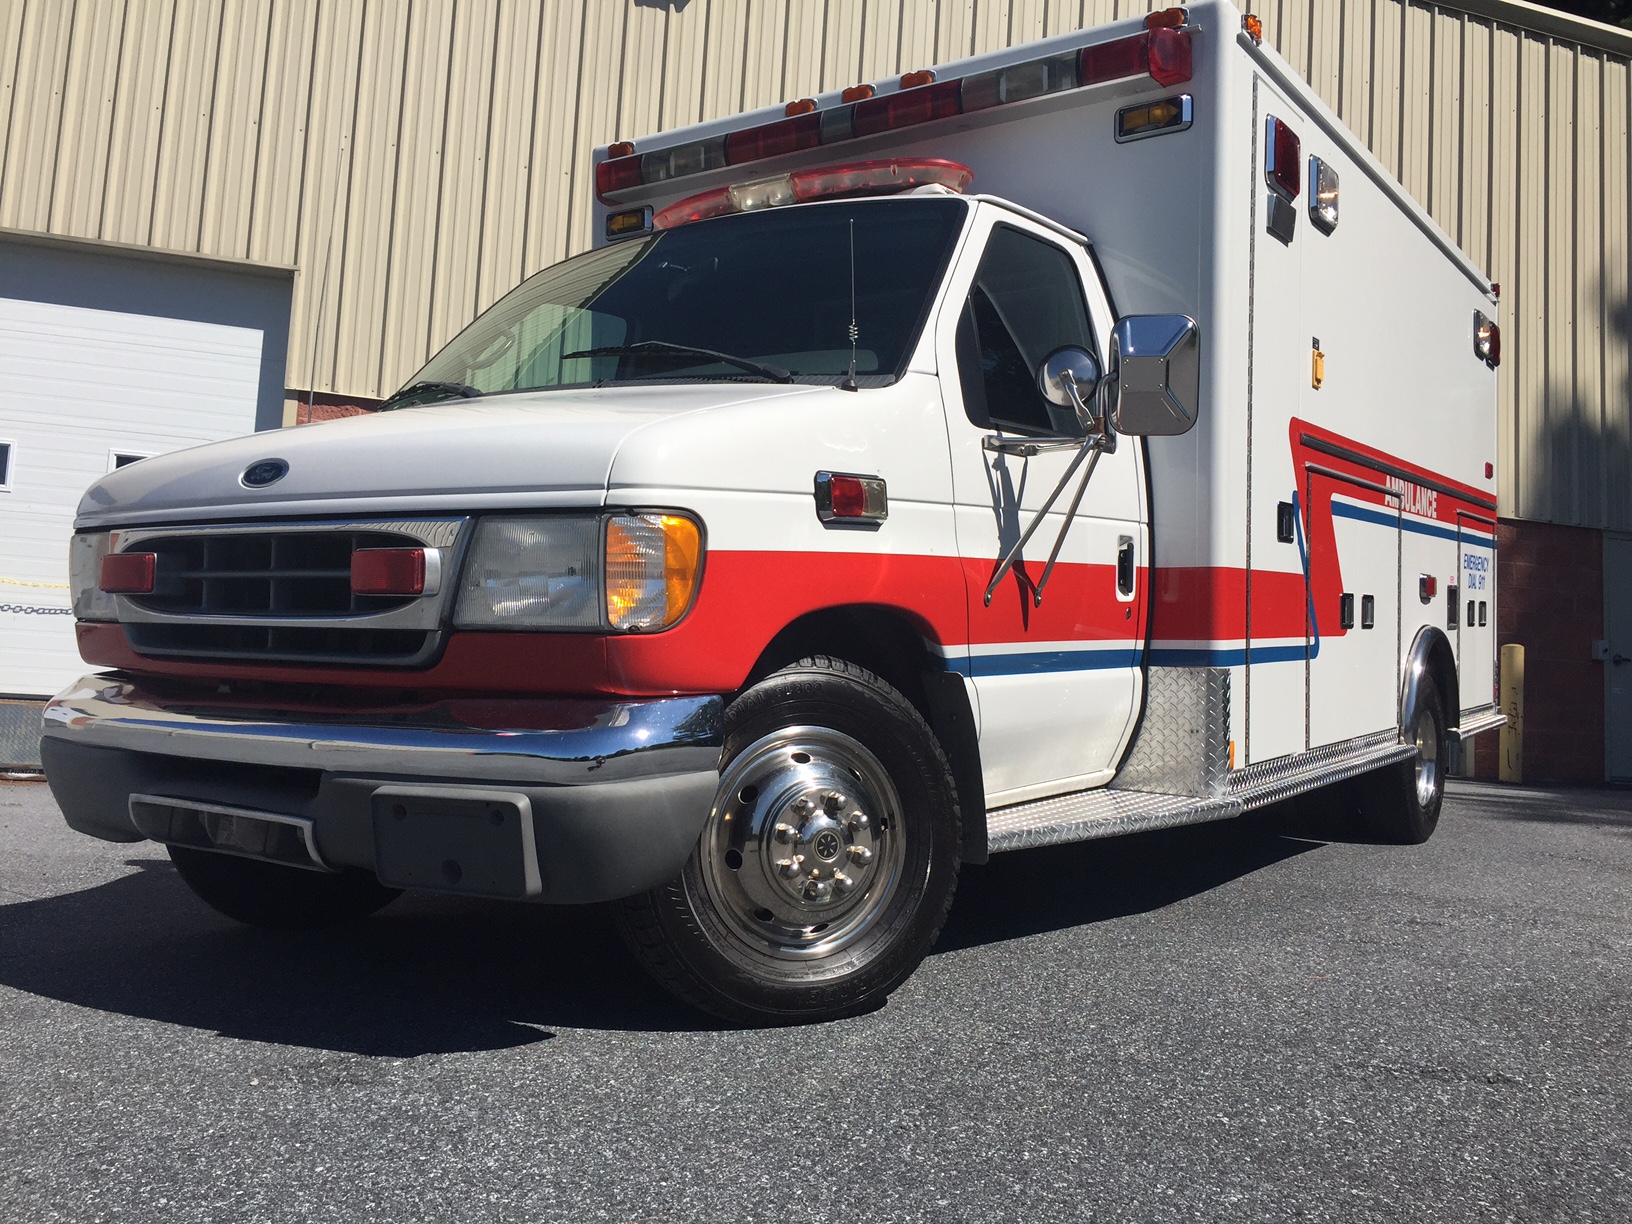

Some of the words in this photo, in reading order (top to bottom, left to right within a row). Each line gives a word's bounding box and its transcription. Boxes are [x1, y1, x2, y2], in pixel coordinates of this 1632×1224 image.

[250, 465, 276, 480] Ford
[1384, 475, 1438, 519] AMBULANCE
[1464, 553, 1489, 572] EMERGENCY
[1468, 573, 1477, 589] DIAL
[1478, 574, 1486, 590] 911
